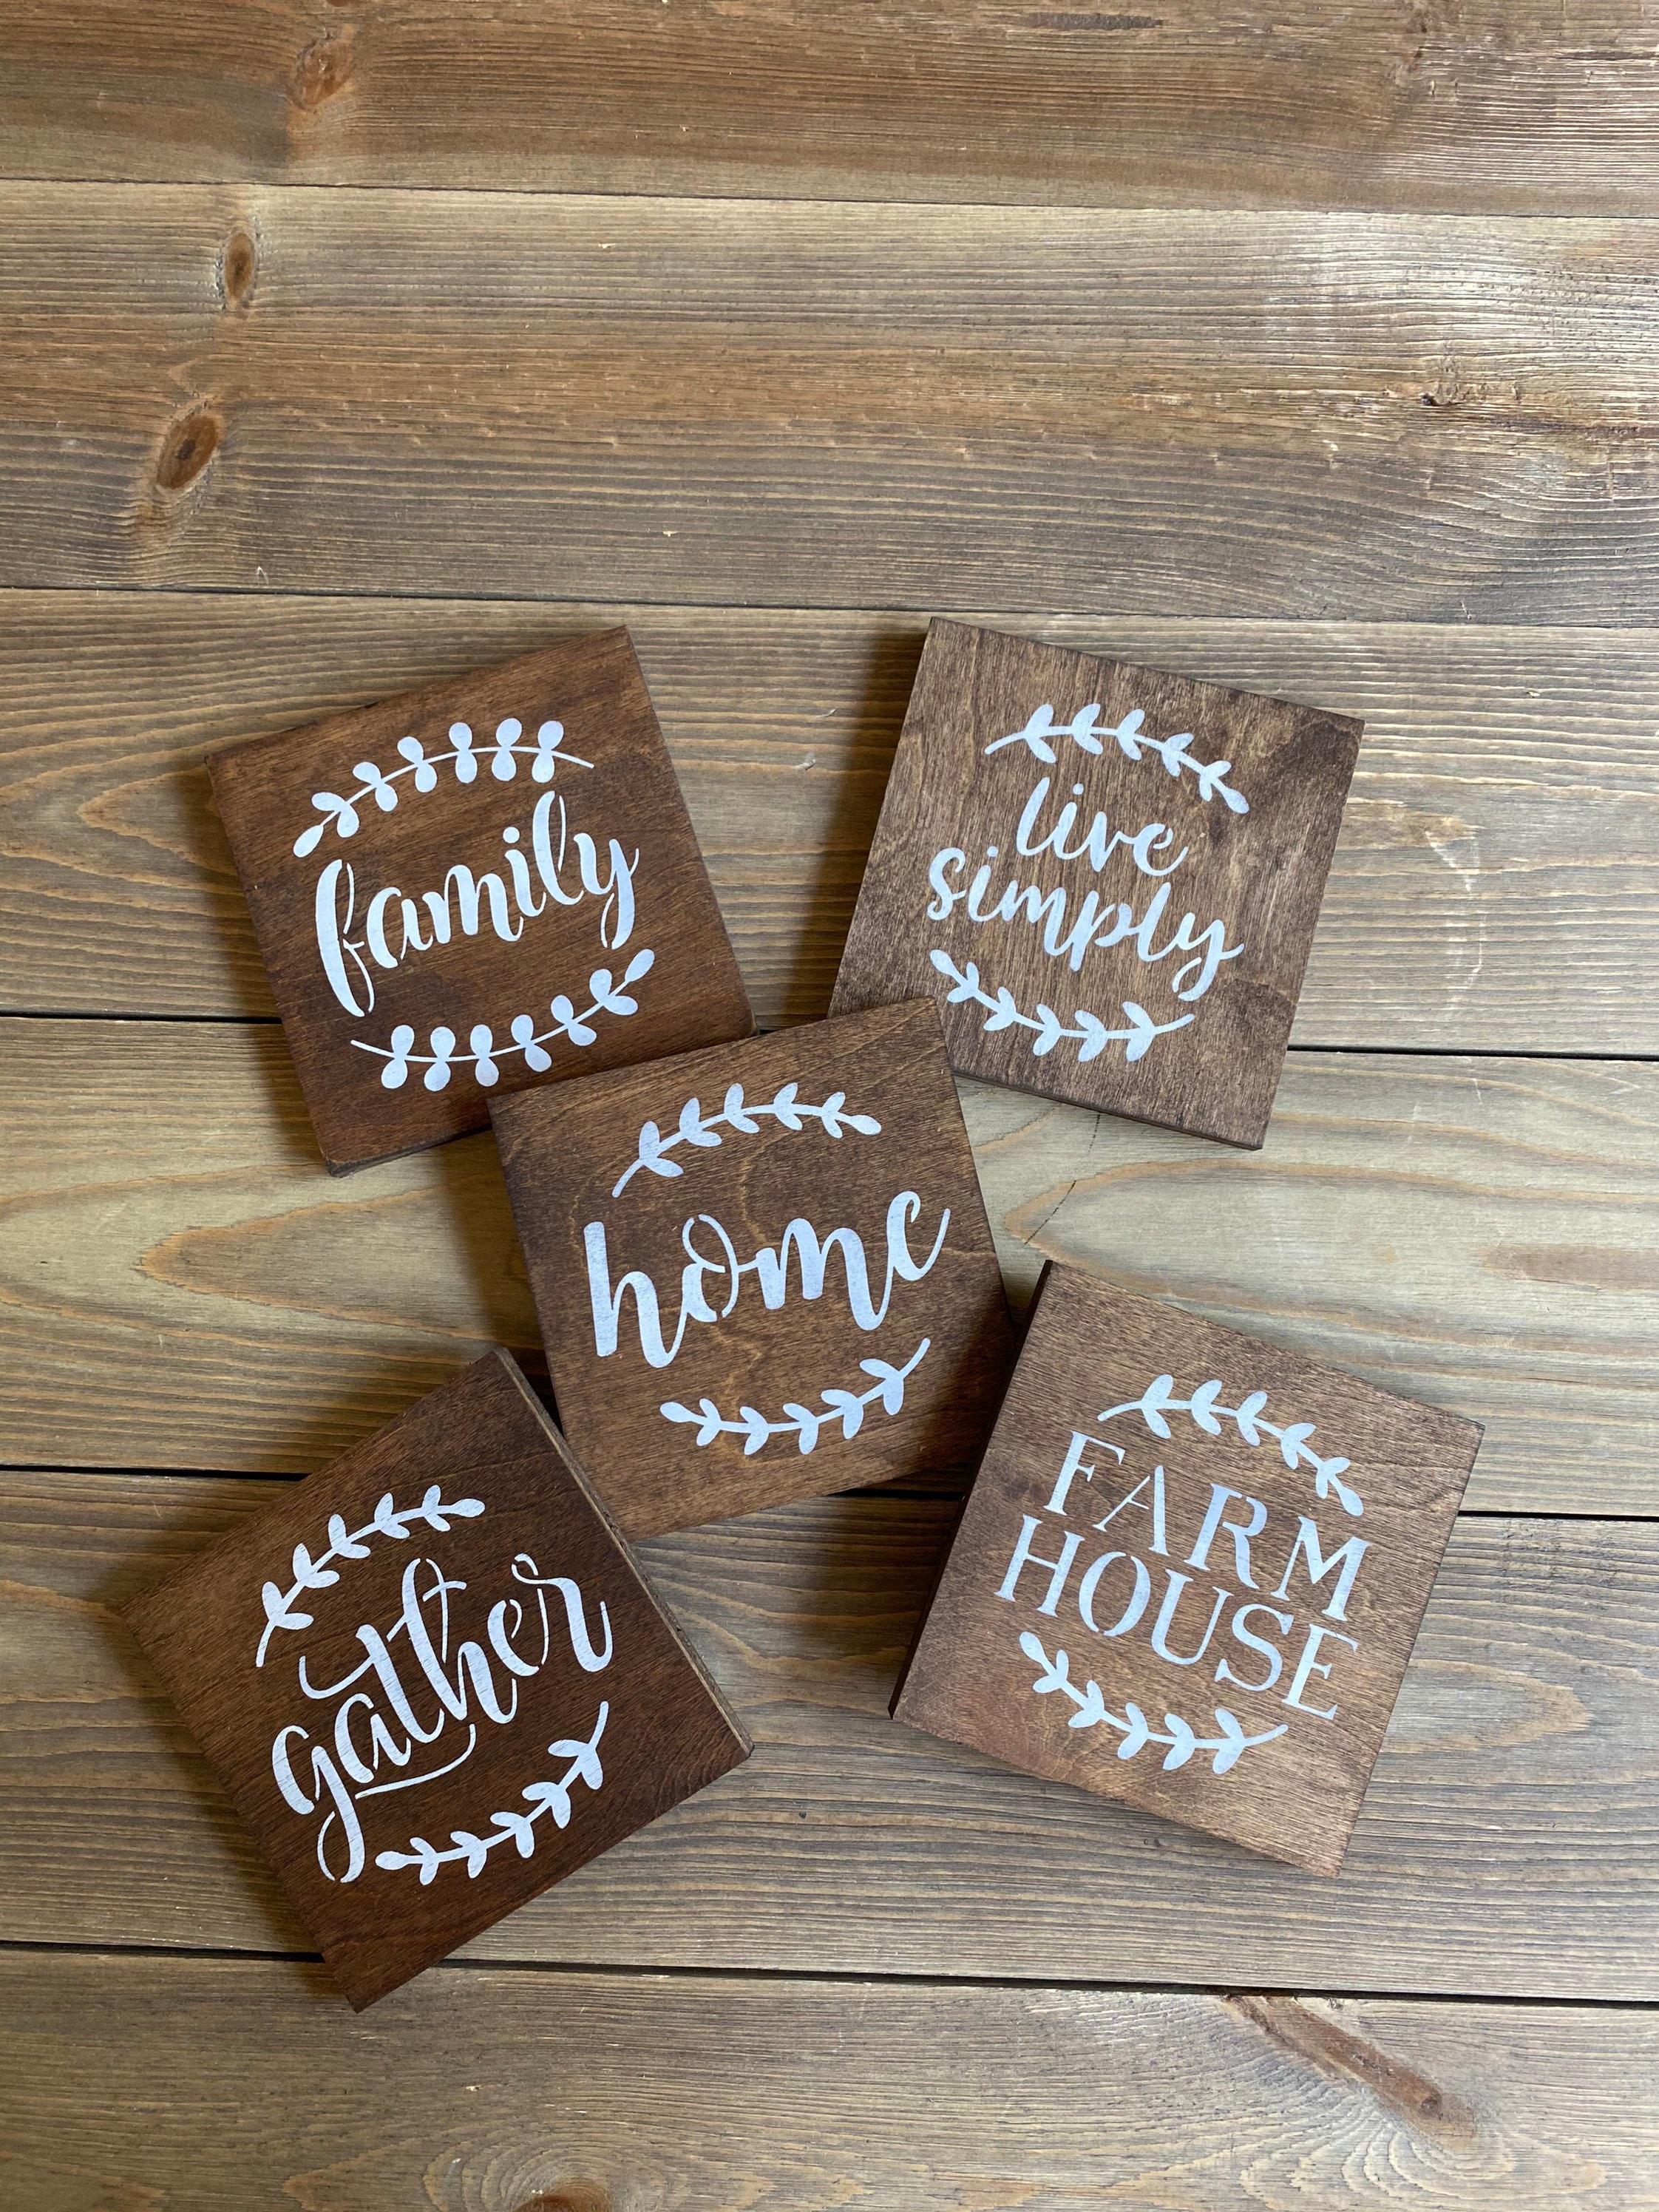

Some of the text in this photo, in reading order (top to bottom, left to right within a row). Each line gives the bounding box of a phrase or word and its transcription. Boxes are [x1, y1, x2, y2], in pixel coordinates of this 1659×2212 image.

[315, 790, 639, 1017] family
[1016, 776, 1189, 877] live
[926, 845, 1245, 1002] simply
[583, 1190, 951, 1368] home
[994, 1514, 1360, 1721] HOUSE
[1042, 1430, 1372, 1622] FARM
[271, 1553, 614, 1884] gather
